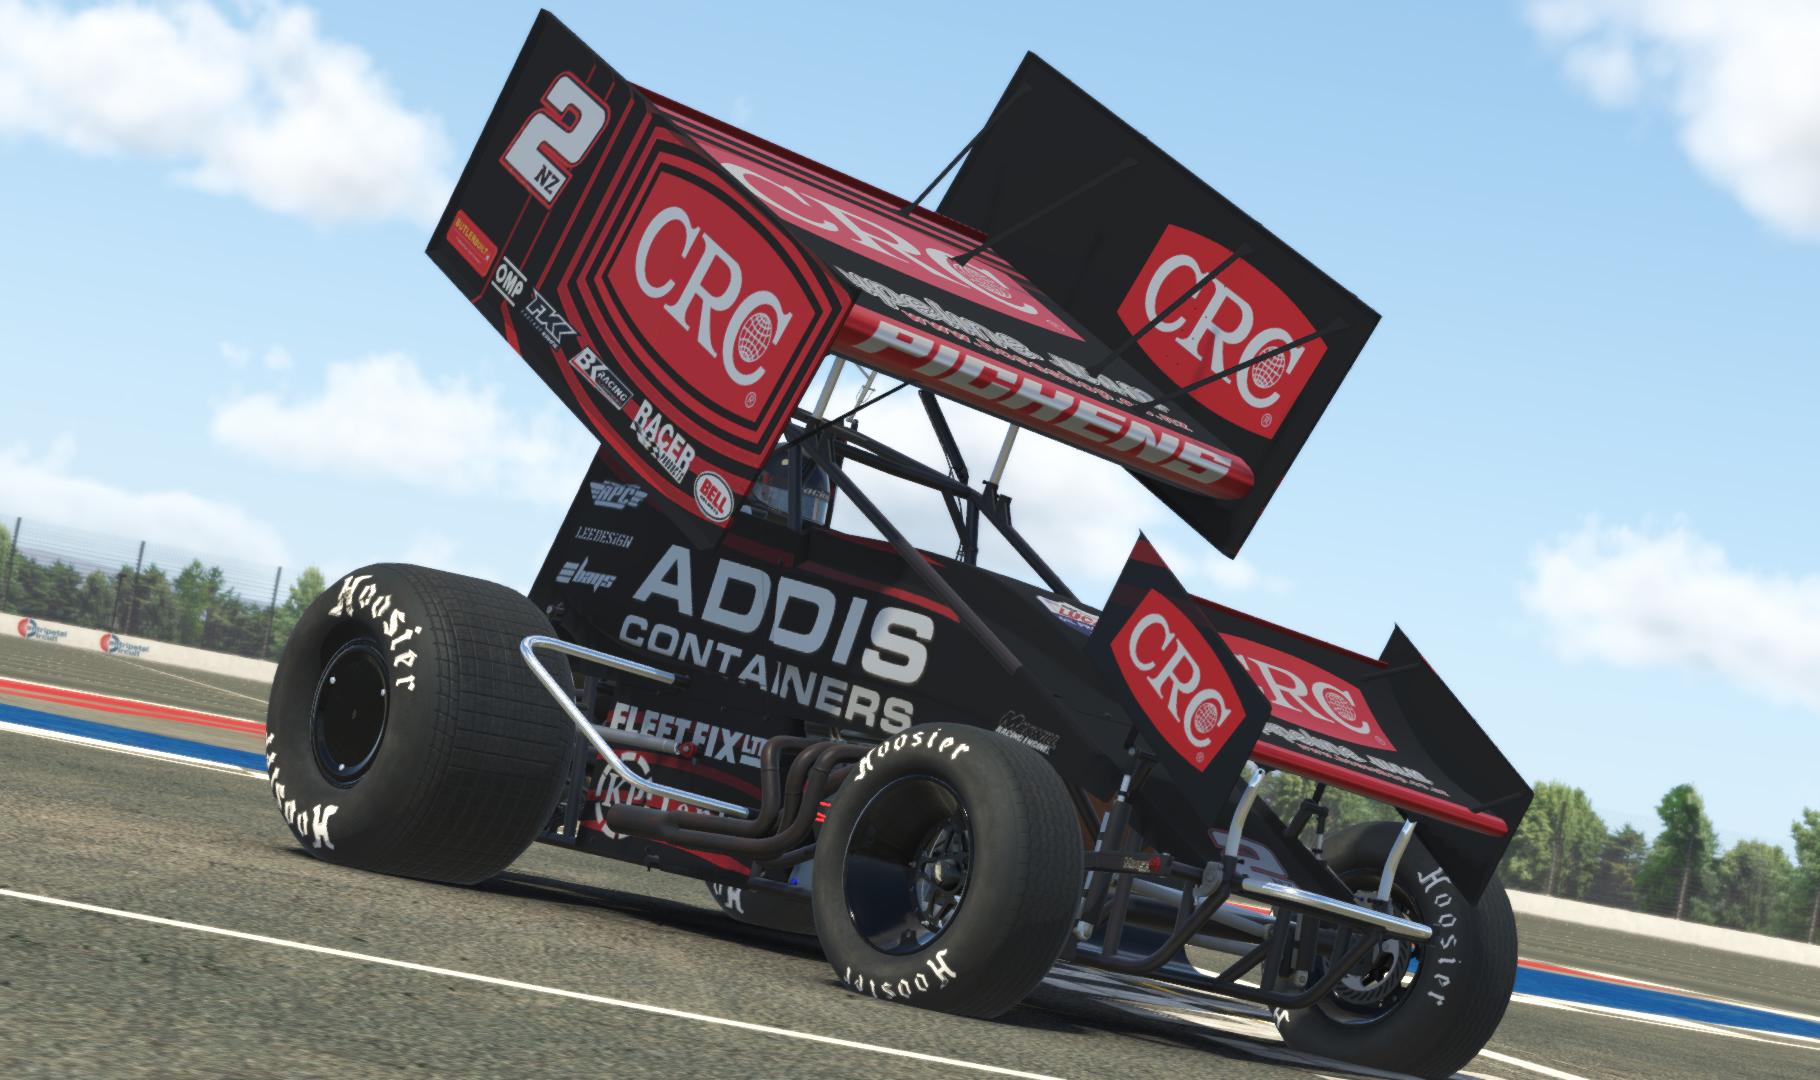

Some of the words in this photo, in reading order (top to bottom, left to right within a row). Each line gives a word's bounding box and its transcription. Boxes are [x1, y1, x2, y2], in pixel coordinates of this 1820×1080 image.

[502, 73, 609, 205] 2
[529, 164, 559, 195] NZ
[495, 263, 524, 298] OMP
[635, 206, 793, 387] CRC
[721, 162, 1037, 315] CRC
[597, 370, 628, 403] RACING
[1145, 254, 1305, 408] CRC
[632, 399, 696, 470] RACER
[700, 478, 727, 514] BELL
[328, 574, 423, 692] Hoosier
[632, 544, 935, 684] ADDIS
[610, 702, 692, 746] FLEET
[692, 720, 744, 764] FIX
[618, 614, 915, 734] CONTAINERS
[1129, 613, 1232, 748] CRC
[1233, 652, 1371, 735] RC
[855, 728, 970, 781] Hoosier
[1417, 866, 1462, 1006] Hoosier
